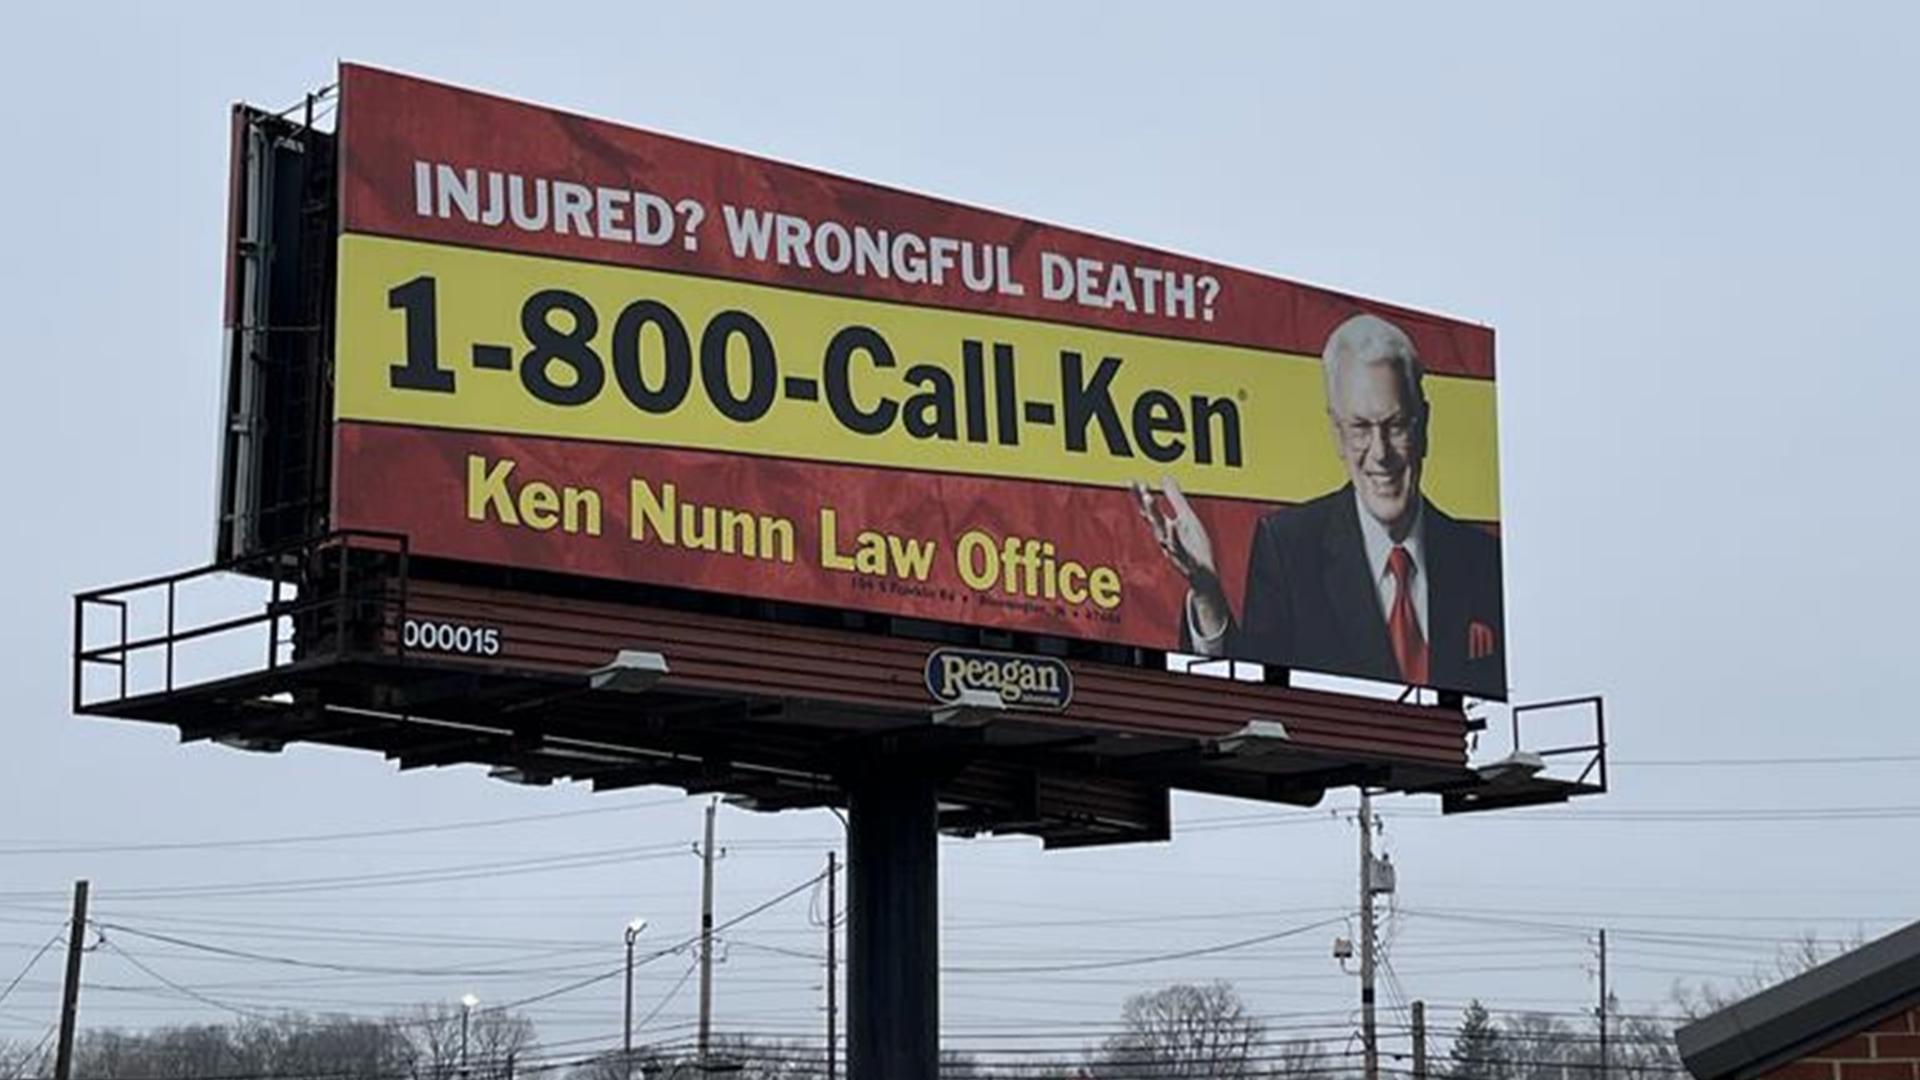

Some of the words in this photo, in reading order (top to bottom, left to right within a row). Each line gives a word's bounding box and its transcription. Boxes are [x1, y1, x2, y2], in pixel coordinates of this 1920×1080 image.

[414, 160, 705, 251] INJURED?
[722, 205, 1024, 297] WRONGFUL
[1040, 251, 1221, 321] DEATH?
[387, 275, 1245, 468] 1-800-Call-Ken
[467, 454, 602, 536] Ken
[630, 477, 795, 564] Nunn
[820, 508, 936, 582] Law
[956, 530, 1121, 609] Office
[403, 620, 500, 656] 000015
[939, 654, 1061, 701] Reagan
